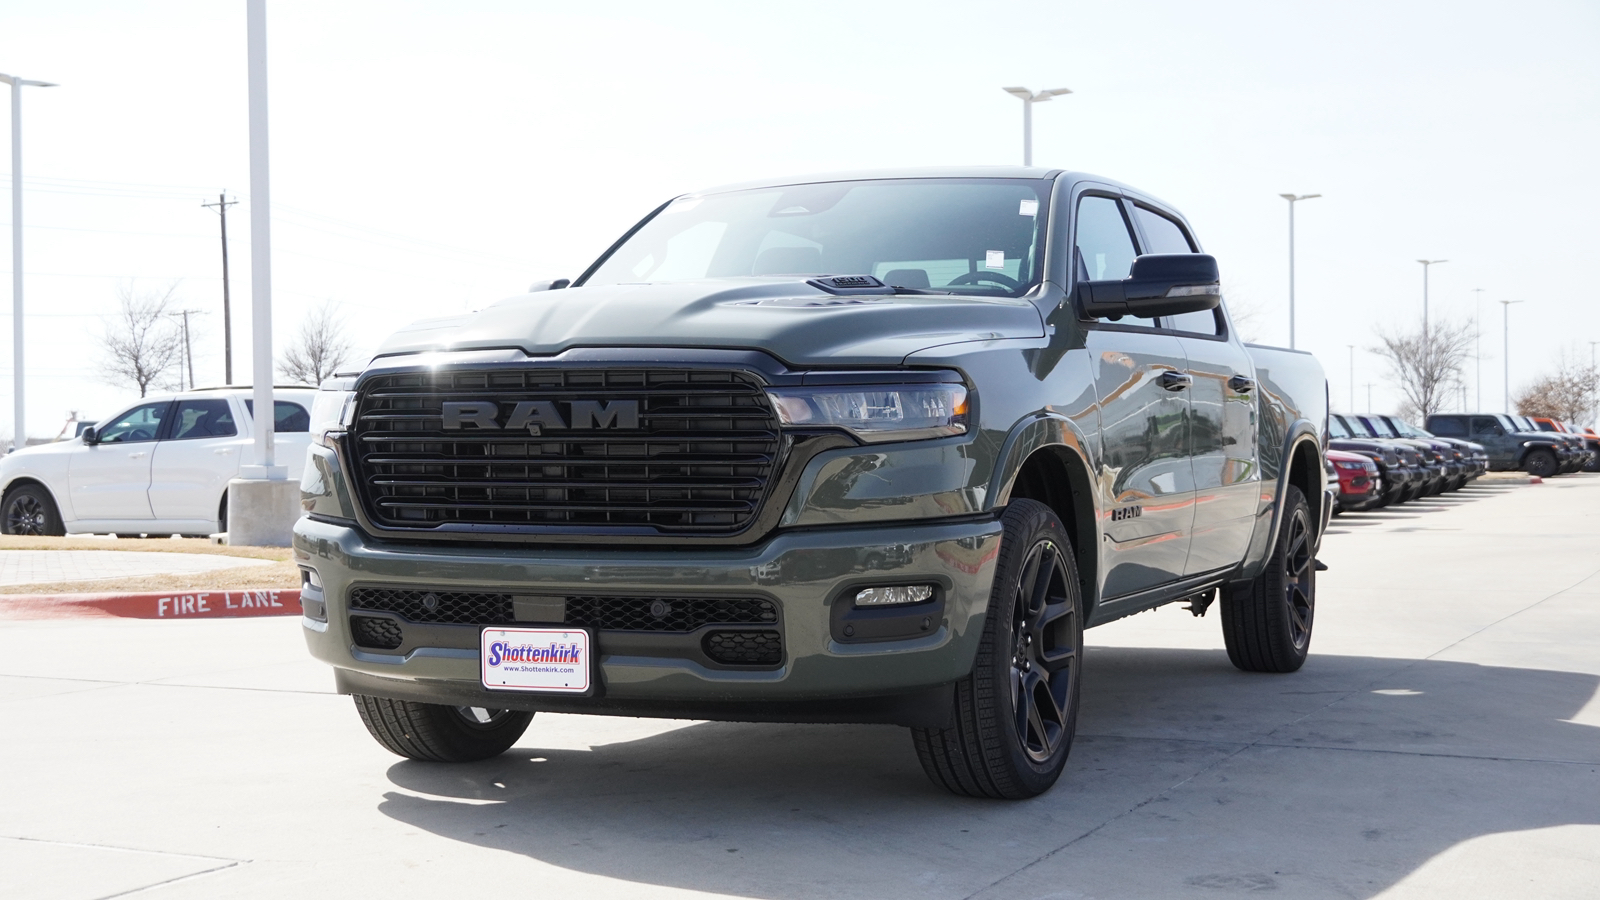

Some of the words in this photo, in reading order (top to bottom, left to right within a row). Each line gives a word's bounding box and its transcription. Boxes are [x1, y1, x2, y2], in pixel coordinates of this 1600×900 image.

[442, 400, 640, 430] RAM
[1111, 505, 1142, 521] RAM
[158, 593, 211, 616] FIRE
[225, 590, 283, 609] LANE
[488, 641, 581, 666] Shottenkirk
[504, 666, 574, 674] www.Shottenkirk.com
